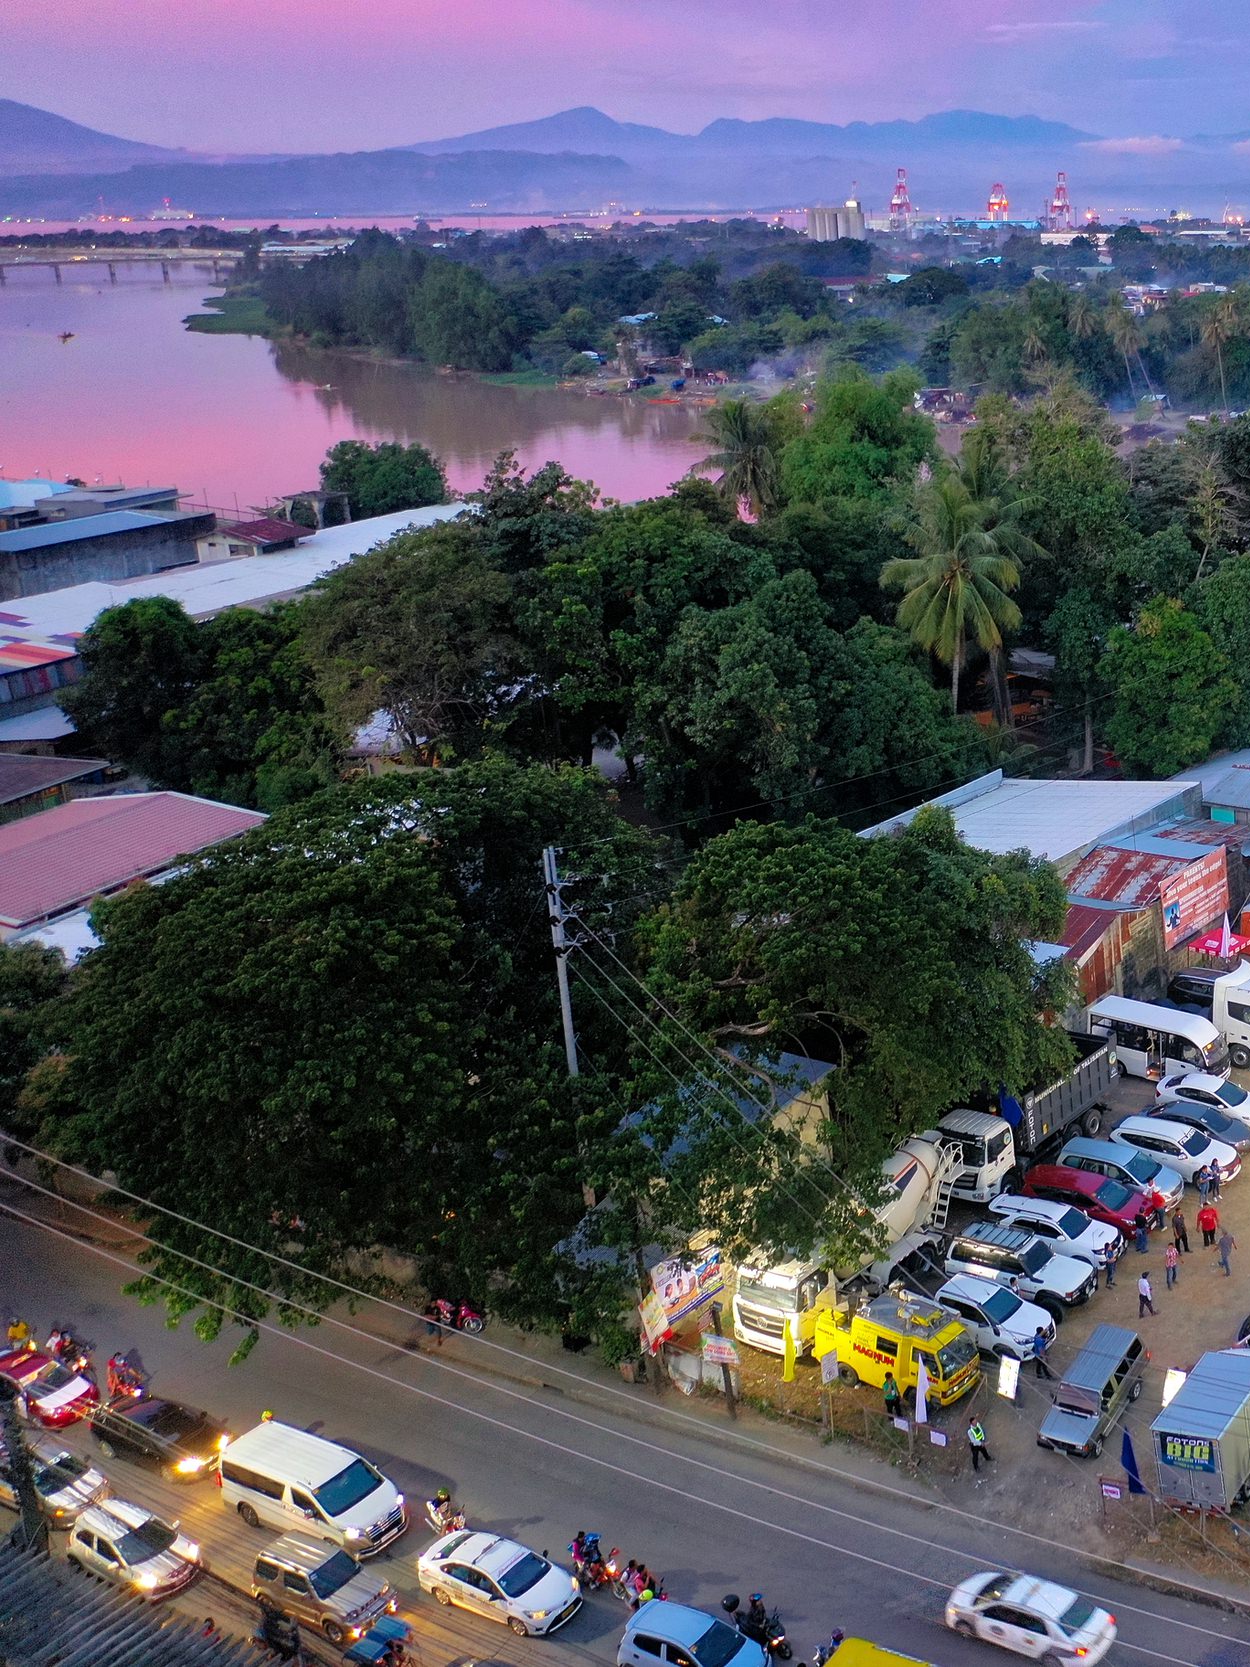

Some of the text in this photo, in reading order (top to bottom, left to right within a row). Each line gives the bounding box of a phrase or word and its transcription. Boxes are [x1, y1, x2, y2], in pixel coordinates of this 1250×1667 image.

[1177, 881, 1188, 895] your
[1034, 1046, 1108, 1103] MUNICIPAL OF TALISAYAN
[1028, 1109, 1036, 1145] FOTON
[853, 1343, 895, 1367] MAGNUM
[1167, 1442, 1210, 1460] BIG
